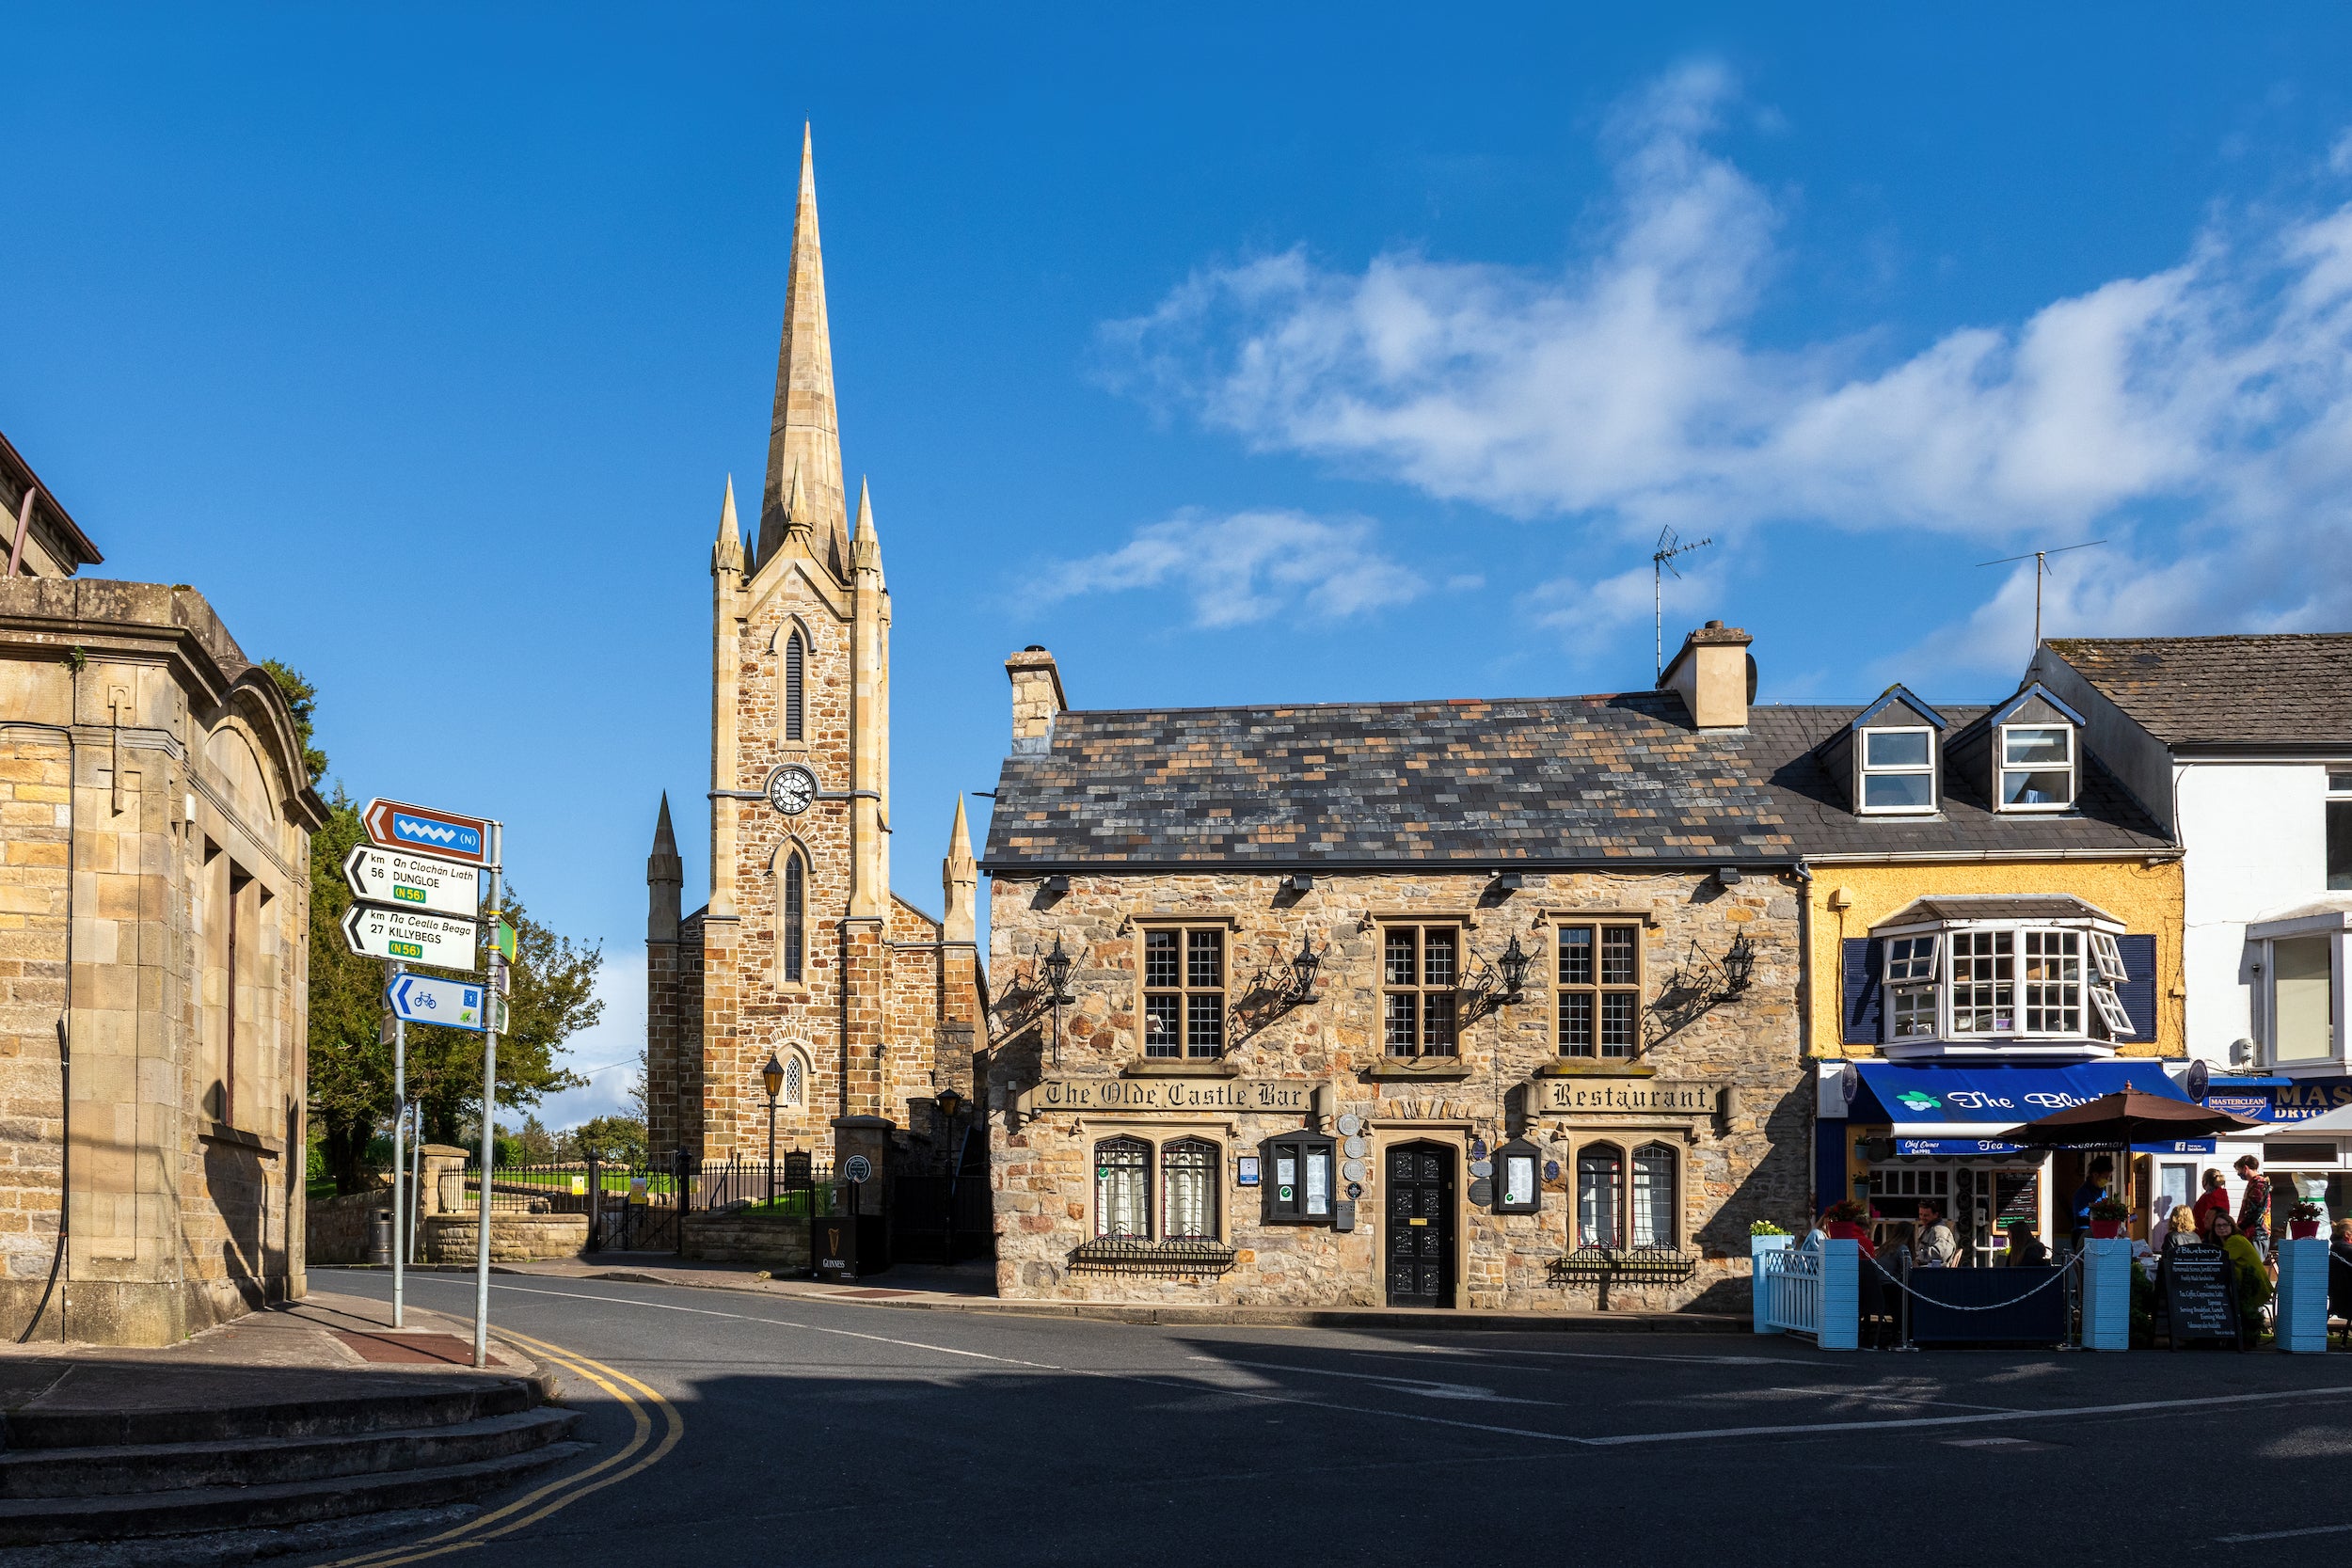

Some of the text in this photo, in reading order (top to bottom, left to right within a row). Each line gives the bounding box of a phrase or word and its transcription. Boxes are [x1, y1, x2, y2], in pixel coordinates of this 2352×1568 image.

[460, 832, 477, 846] (N)
[371, 853, 385, 864] km
[410, 861, 448, 877] Clochán
[371, 867, 440, 888] 56 DUNGLOE
[395, 887, 424, 901] (N 56)
[371, 910, 385, 920] km
[407, 916, 439, 930] Cealla
[441, 922, 471, 936] Beaga
[371, 924, 441, 944] 27 KILLYBEGS
[390, 942, 421, 957] (N 56)
[1045, 1081, 1302, 1107] The Olde Castle Bar
[1553, 1083, 1707, 1107] Restaurant
[1947, 1091, 2015, 1109] The
[2275, 1085, 2352, 1106] MAS
[1977, 1140, 2004, 1151] Tea
[2181, 1246, 2222, 1259] Blueberry
[822, 1258, 846, 1268] GUINNESS
